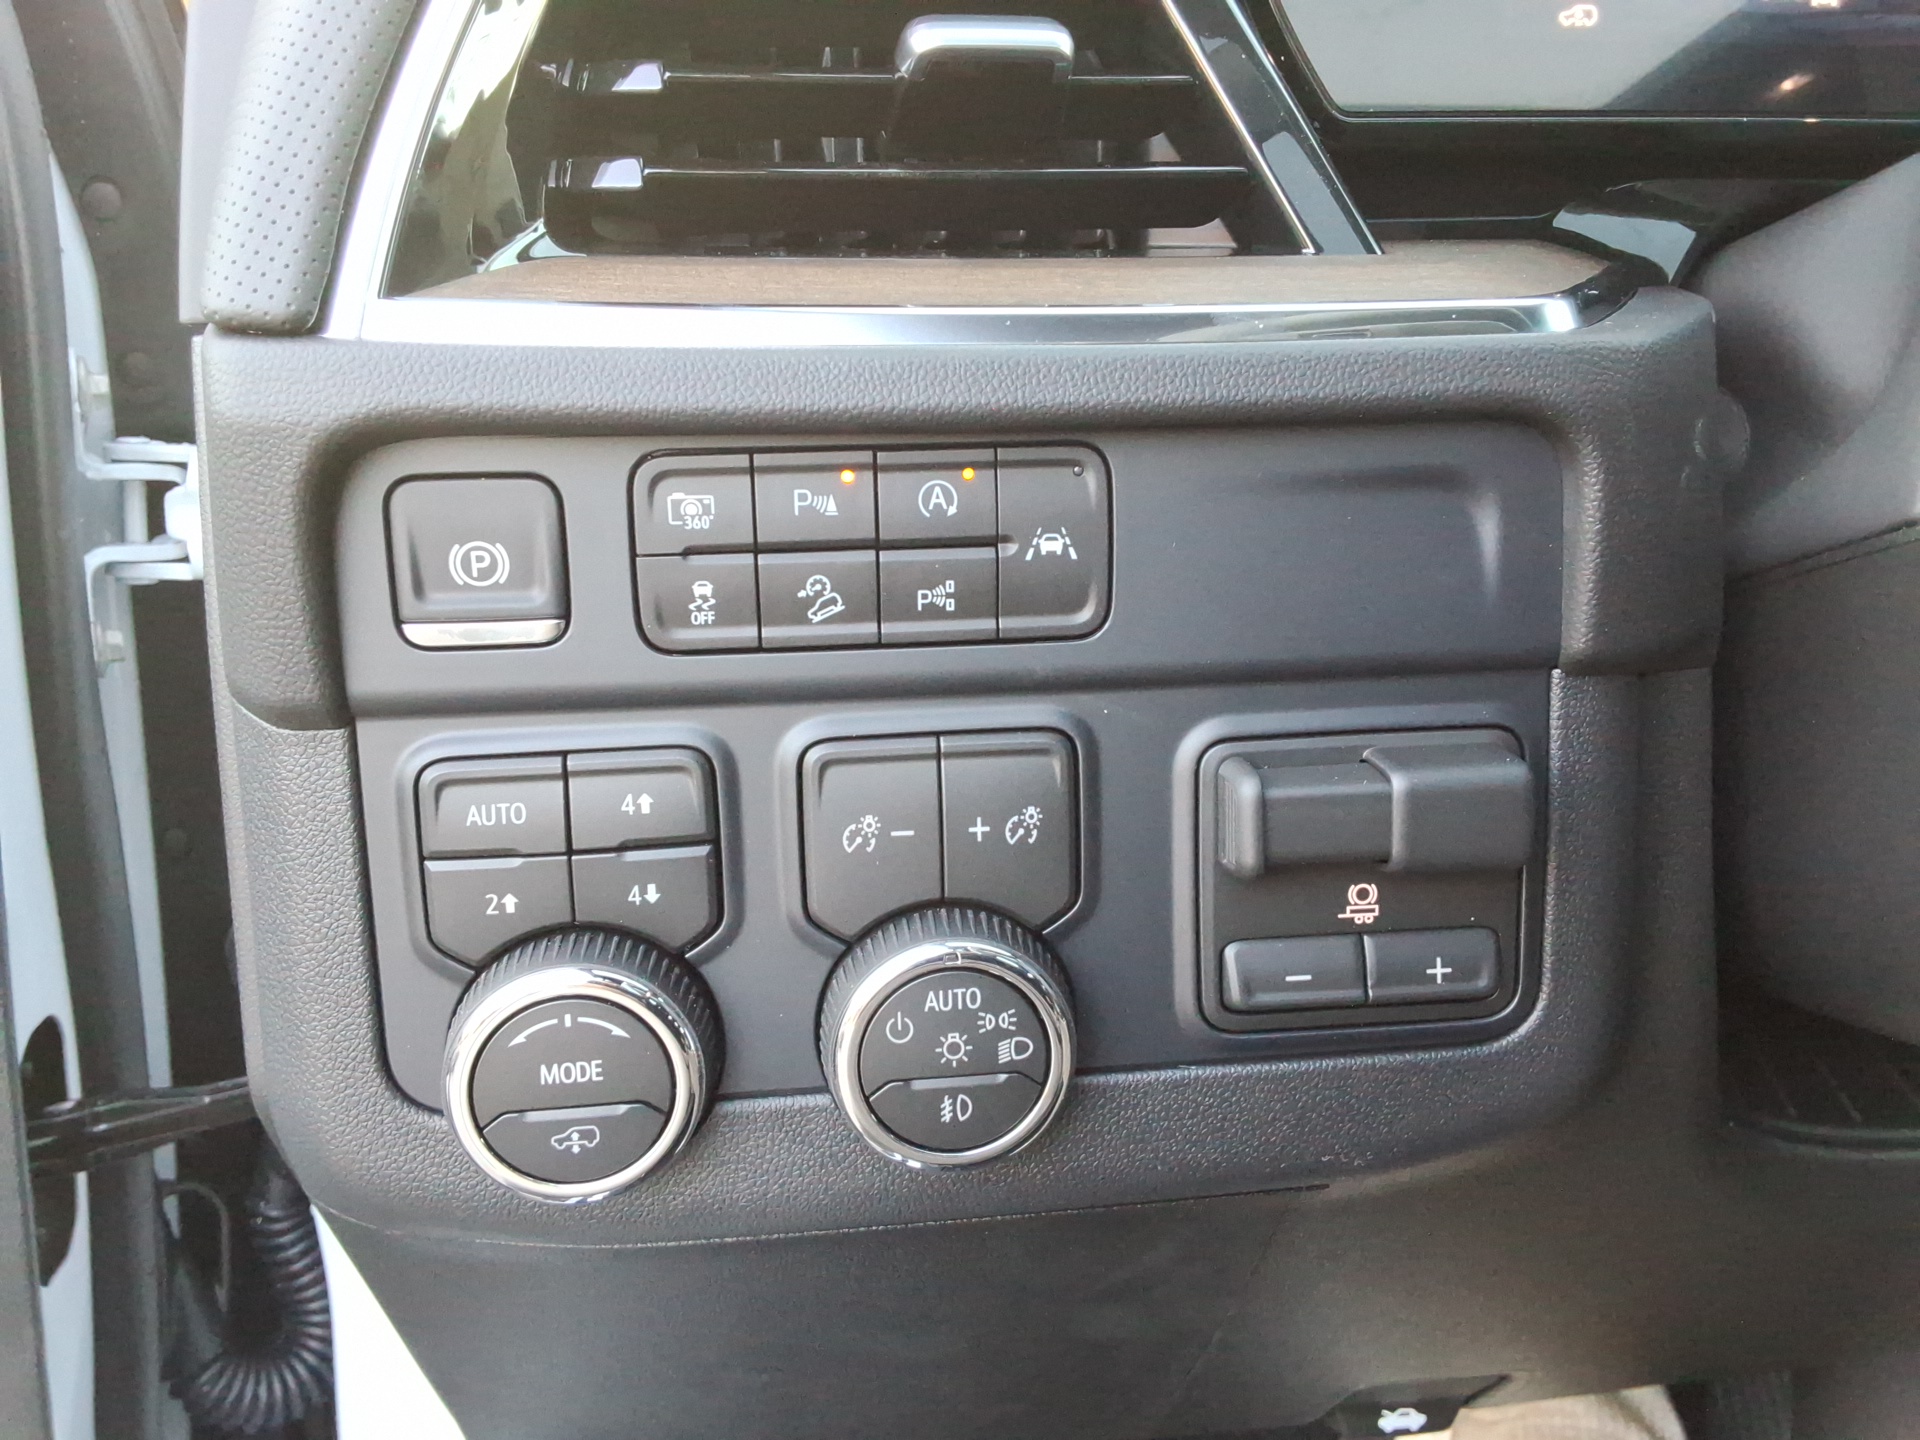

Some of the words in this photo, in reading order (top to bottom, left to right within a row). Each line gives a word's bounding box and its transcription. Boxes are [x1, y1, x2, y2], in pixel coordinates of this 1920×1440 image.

[793, 489, 813, 516] P
[929, 486, 948, 510] A
[469, 550, 491, 578] P
[917, 590, 932, 611] P
[690, 611, 715, 625] OFF
[466, 802, 527, 827] AUTO
[620, 793, 636, 815] 4
[485, 893, 500, 915] 2
[627, 885, 642, 906] 4
[924, 987, 982, 1012] AUTO
[540, 1060, 604, 1085] MODE
